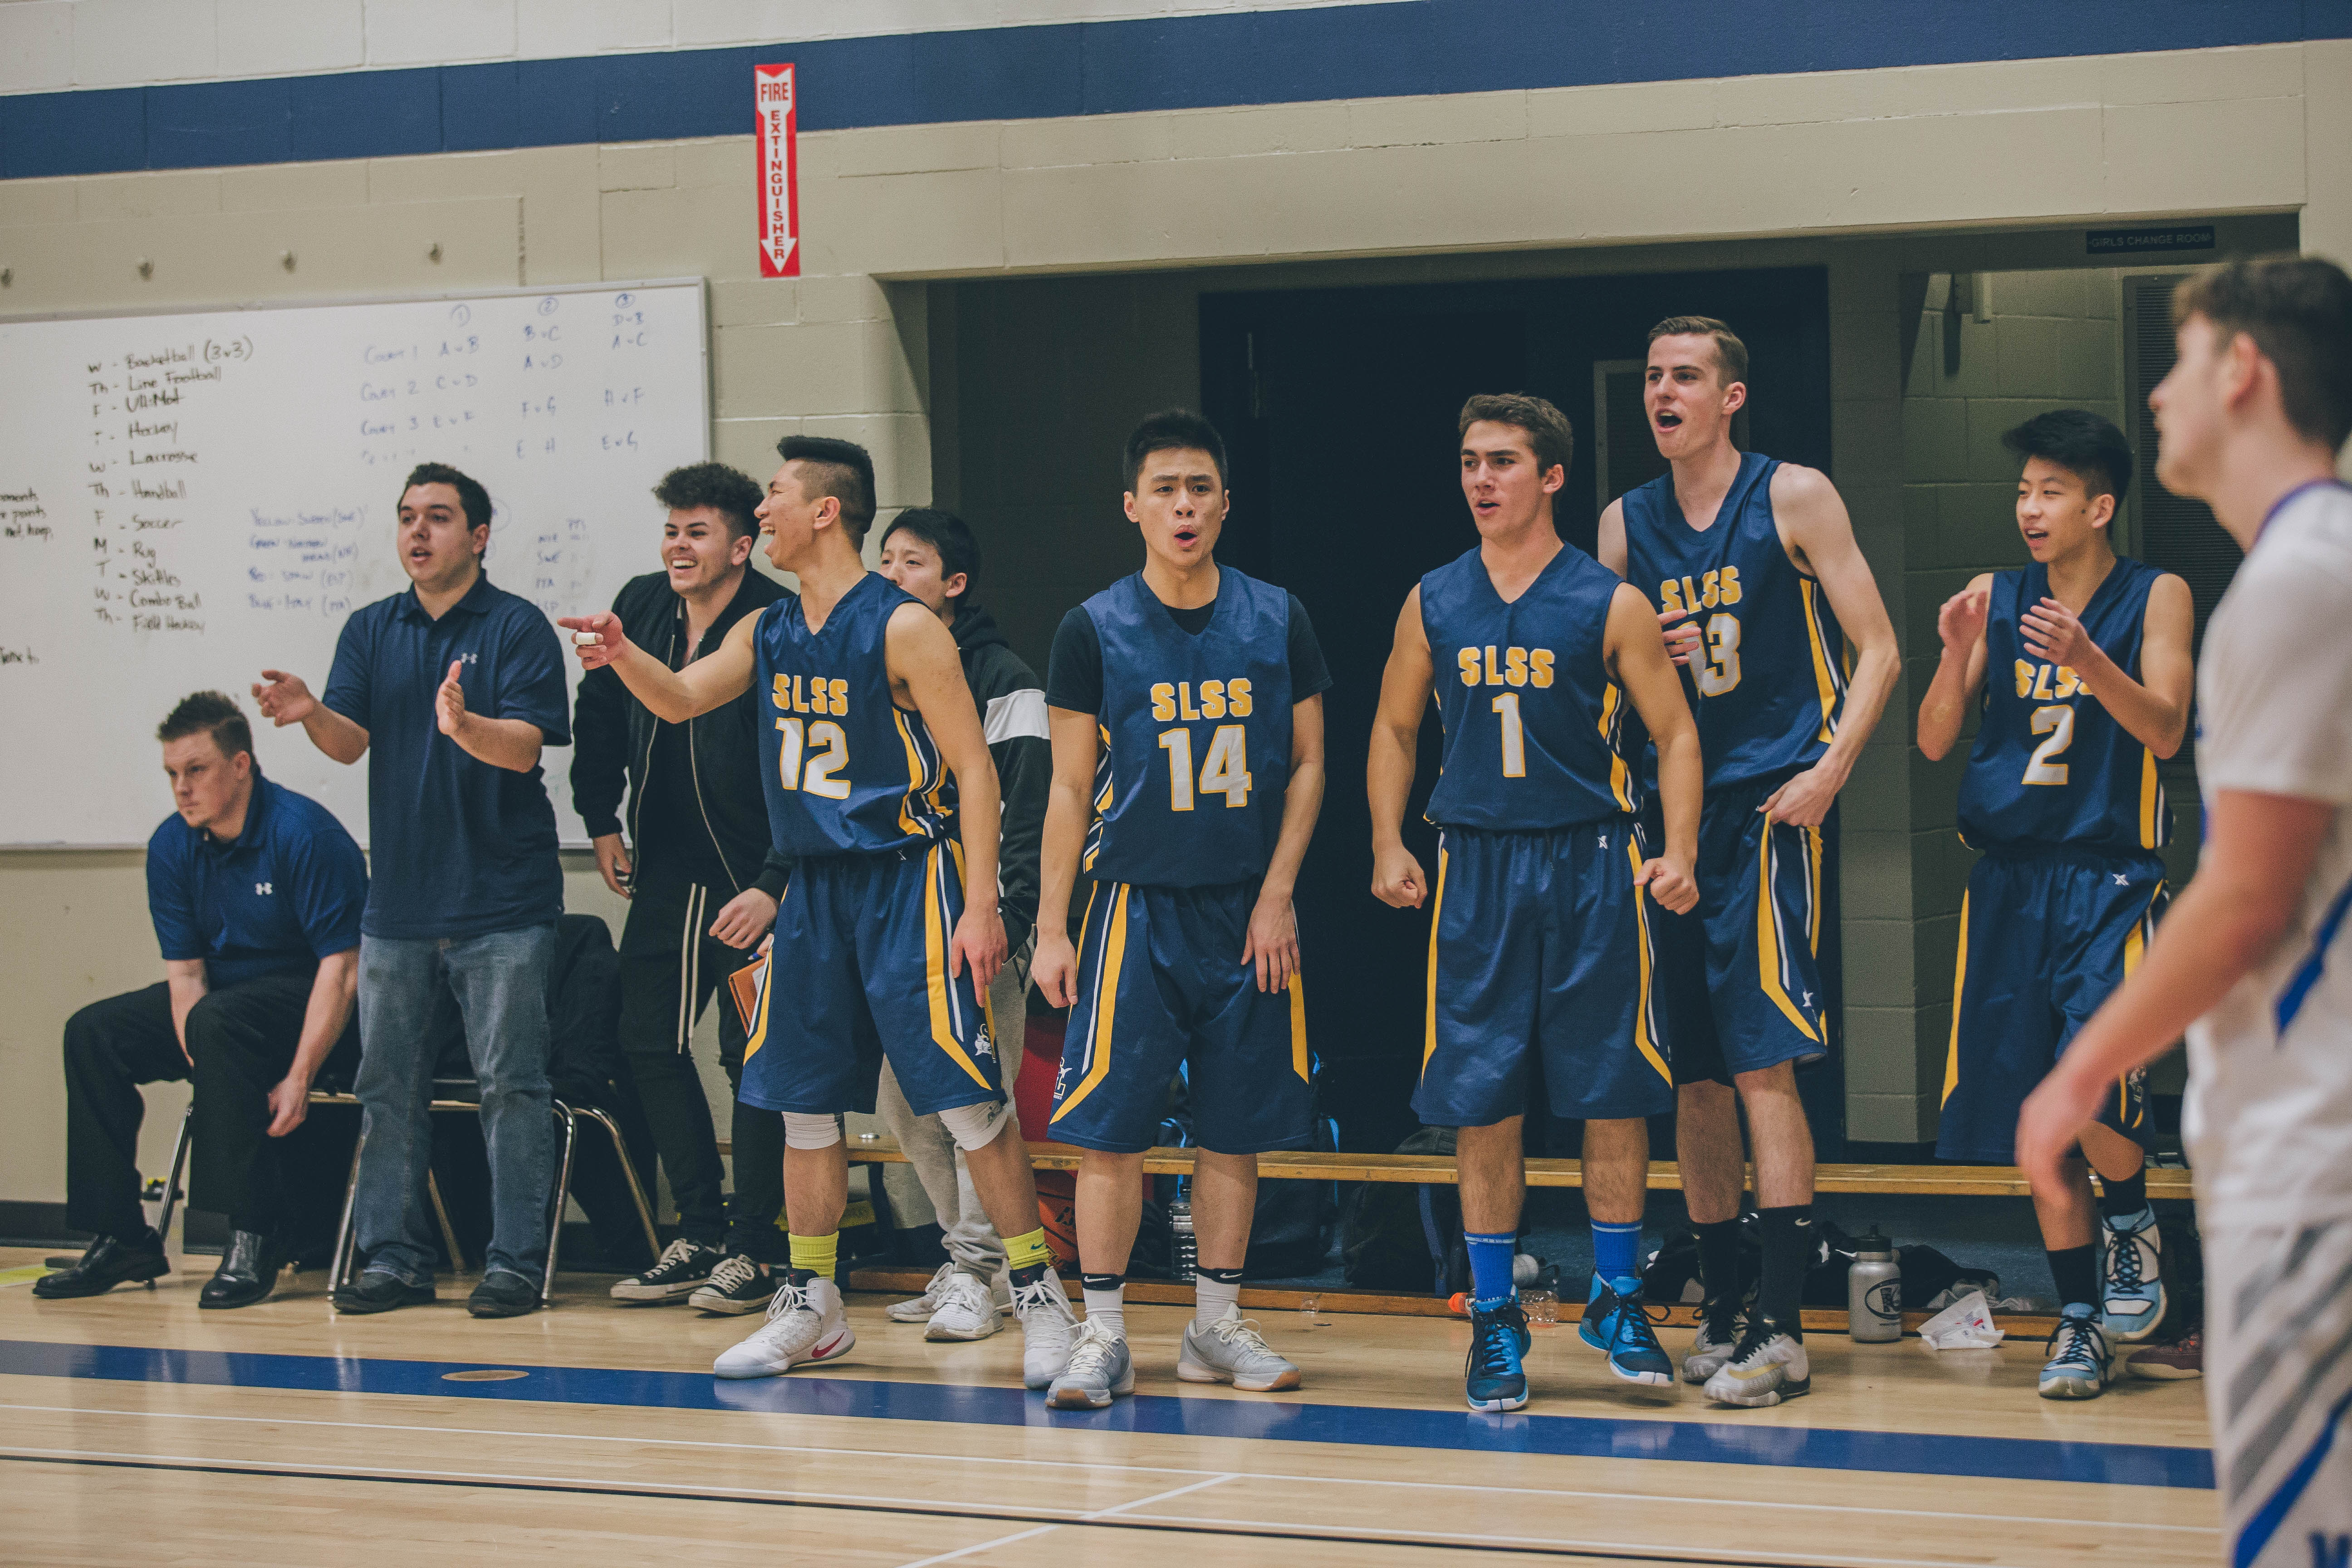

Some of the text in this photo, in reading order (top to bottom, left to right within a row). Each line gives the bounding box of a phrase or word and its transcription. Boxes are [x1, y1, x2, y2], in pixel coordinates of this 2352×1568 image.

[760, 82, 789, 103] FIRE
[770, 110, 785, 260] EXTINGUISHER
[2090, 232, 2212, 248] GIRLS CHANGE ROOM
[1660, 565, 1743, 615] SLSS
[1457, 645, 1555, 689] SLSS
[1674, 612, 1742, 700] 13
[772, 673, 848, 716] SLSS
[1150, 677, 1253, 722] SLSS
[774, 716, 852, 800] 12
[1158, 724, 1252, 811] 14
[1492, 691, 1527, 778] 1
[2021, 704, 2075, 786] 2
